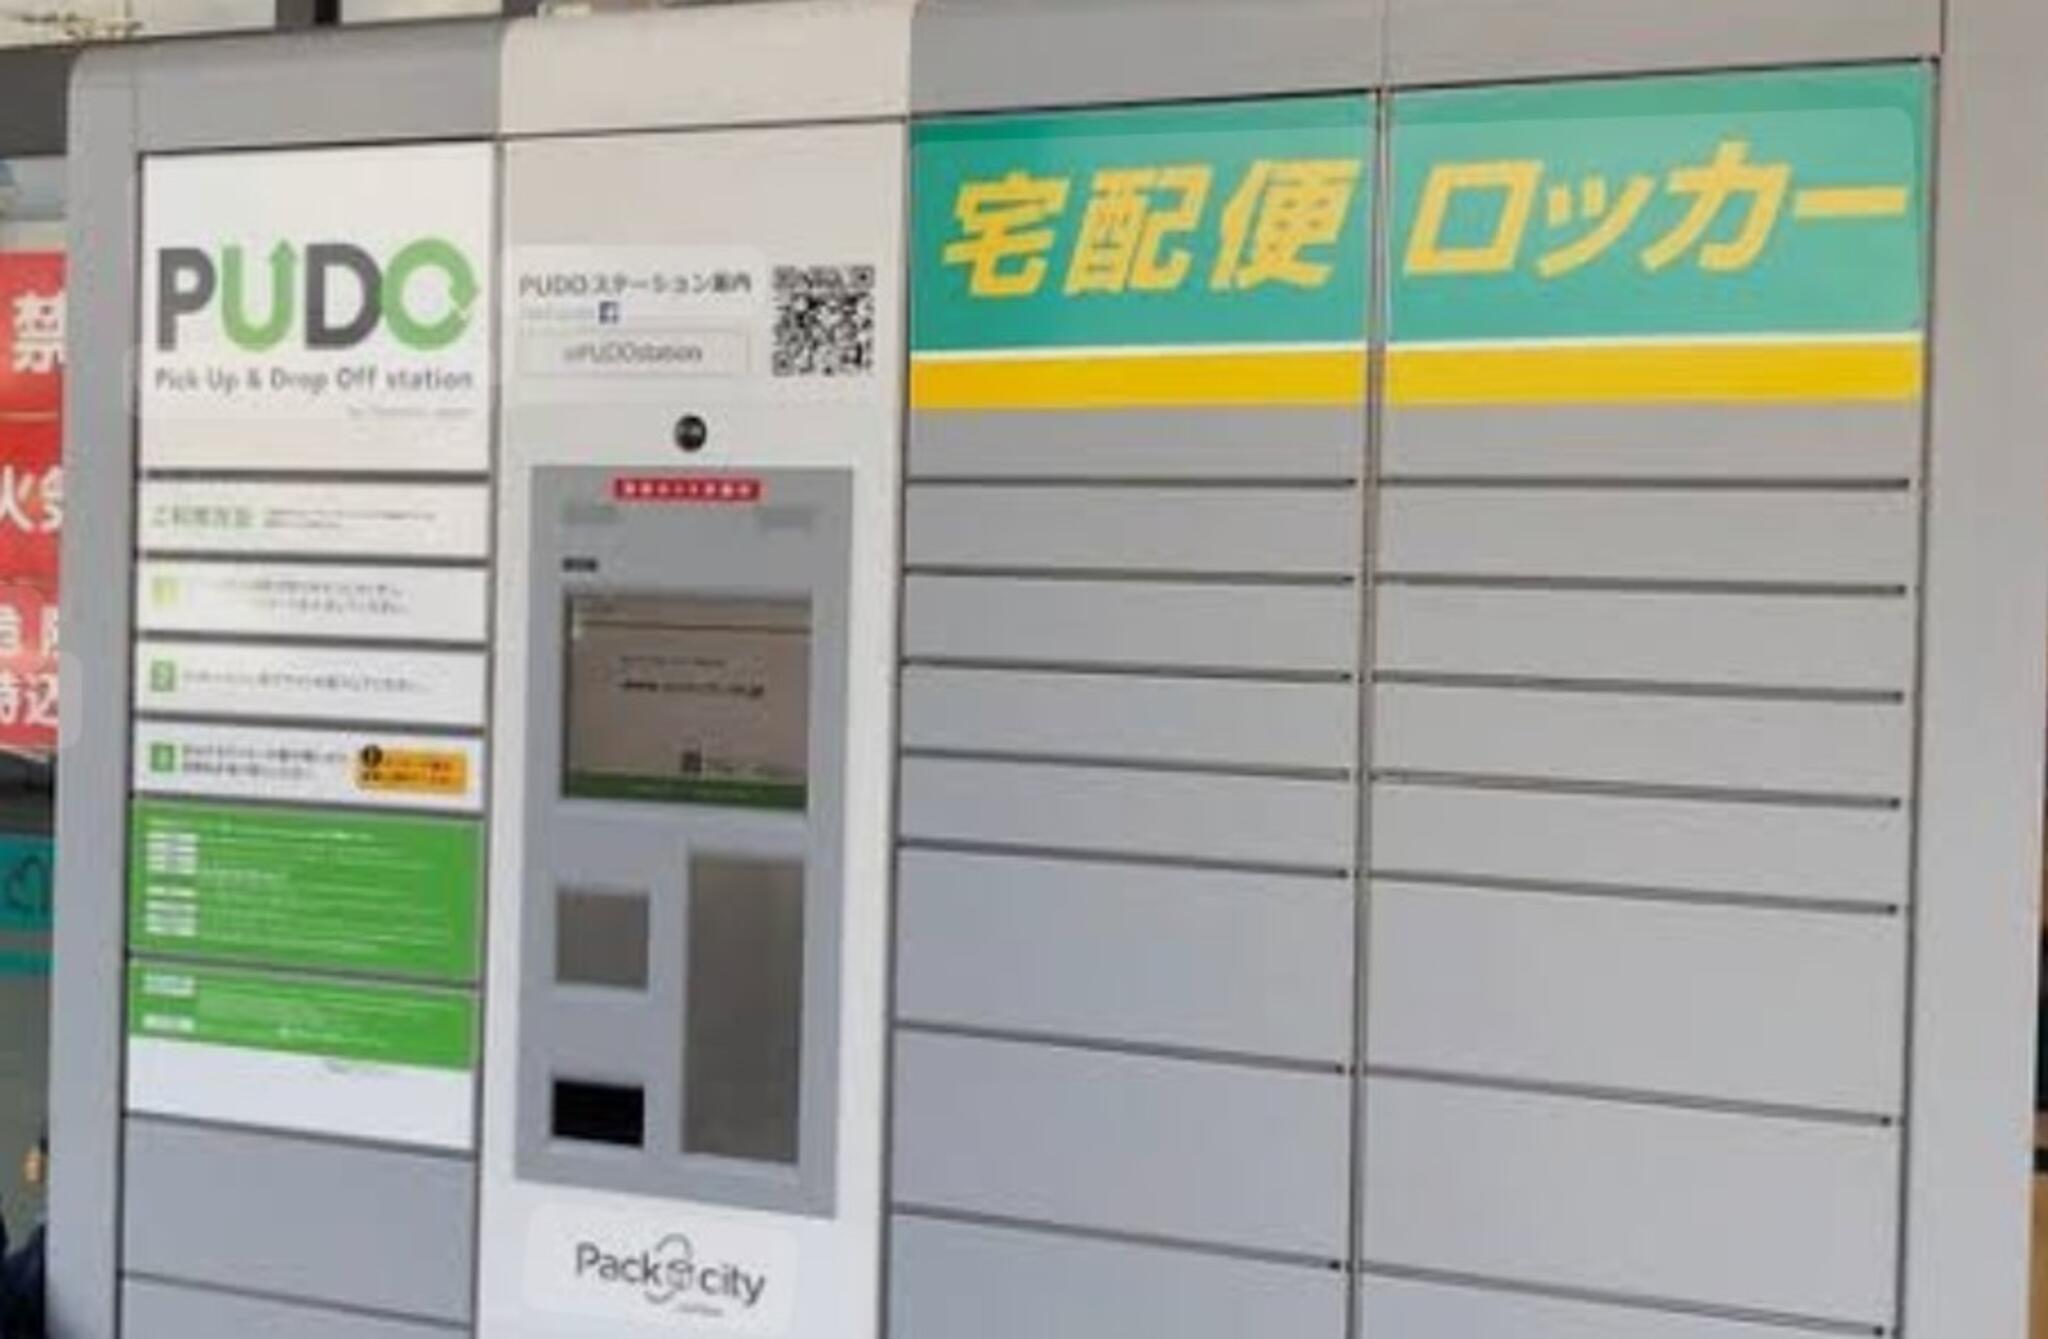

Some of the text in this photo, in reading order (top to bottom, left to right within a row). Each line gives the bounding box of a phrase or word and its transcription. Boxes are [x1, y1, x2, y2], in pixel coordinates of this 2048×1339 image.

[943, 139, 1907, 297] 宅配便 ロッカー
[156, 238, 480, 352] PUDO
[155, 366, 474, 394] Pick Up & Drop Off station
[575, 1241, 766, 1307] Pack city
